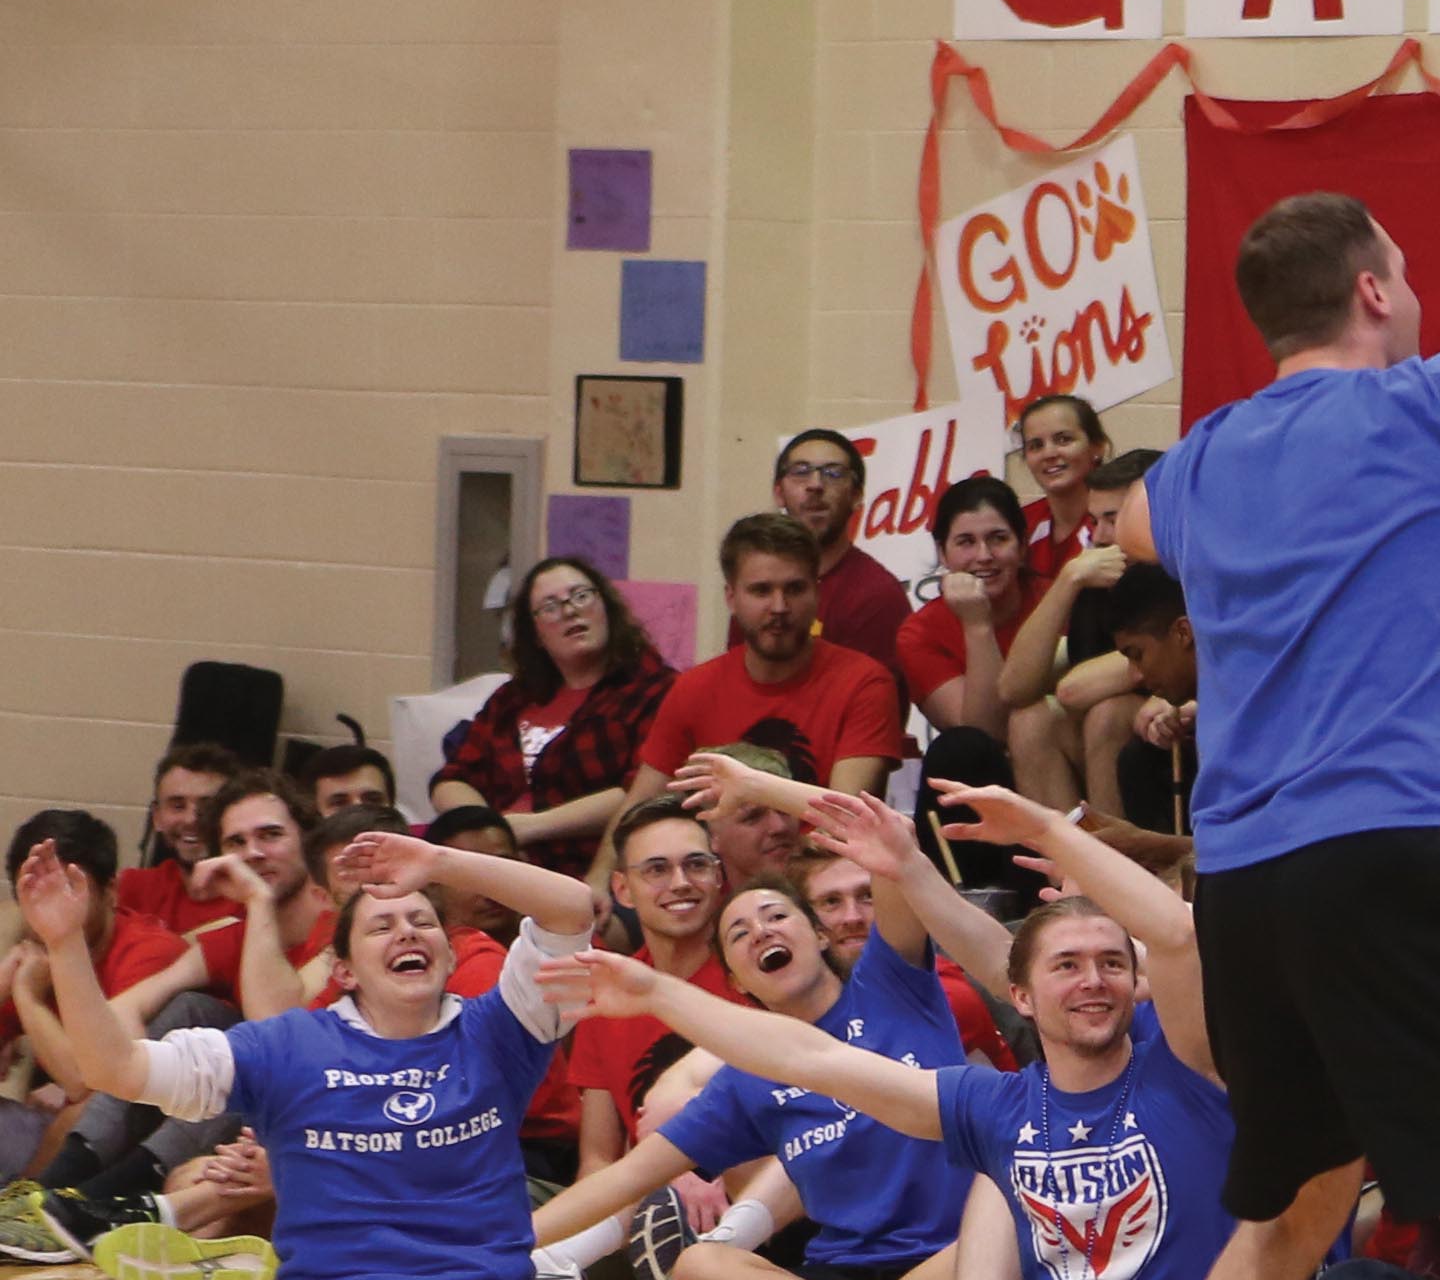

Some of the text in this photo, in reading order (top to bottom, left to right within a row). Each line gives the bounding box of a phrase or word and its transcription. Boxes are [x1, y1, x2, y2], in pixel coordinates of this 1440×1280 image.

[957, 181, 1080, 314] GO
[323, 1064, 450, 1089] PROPERTY
[304, 1107, 503, 1153] BATSON COLLEGE
[1018, 1149, 1149, 1204] BATSON
